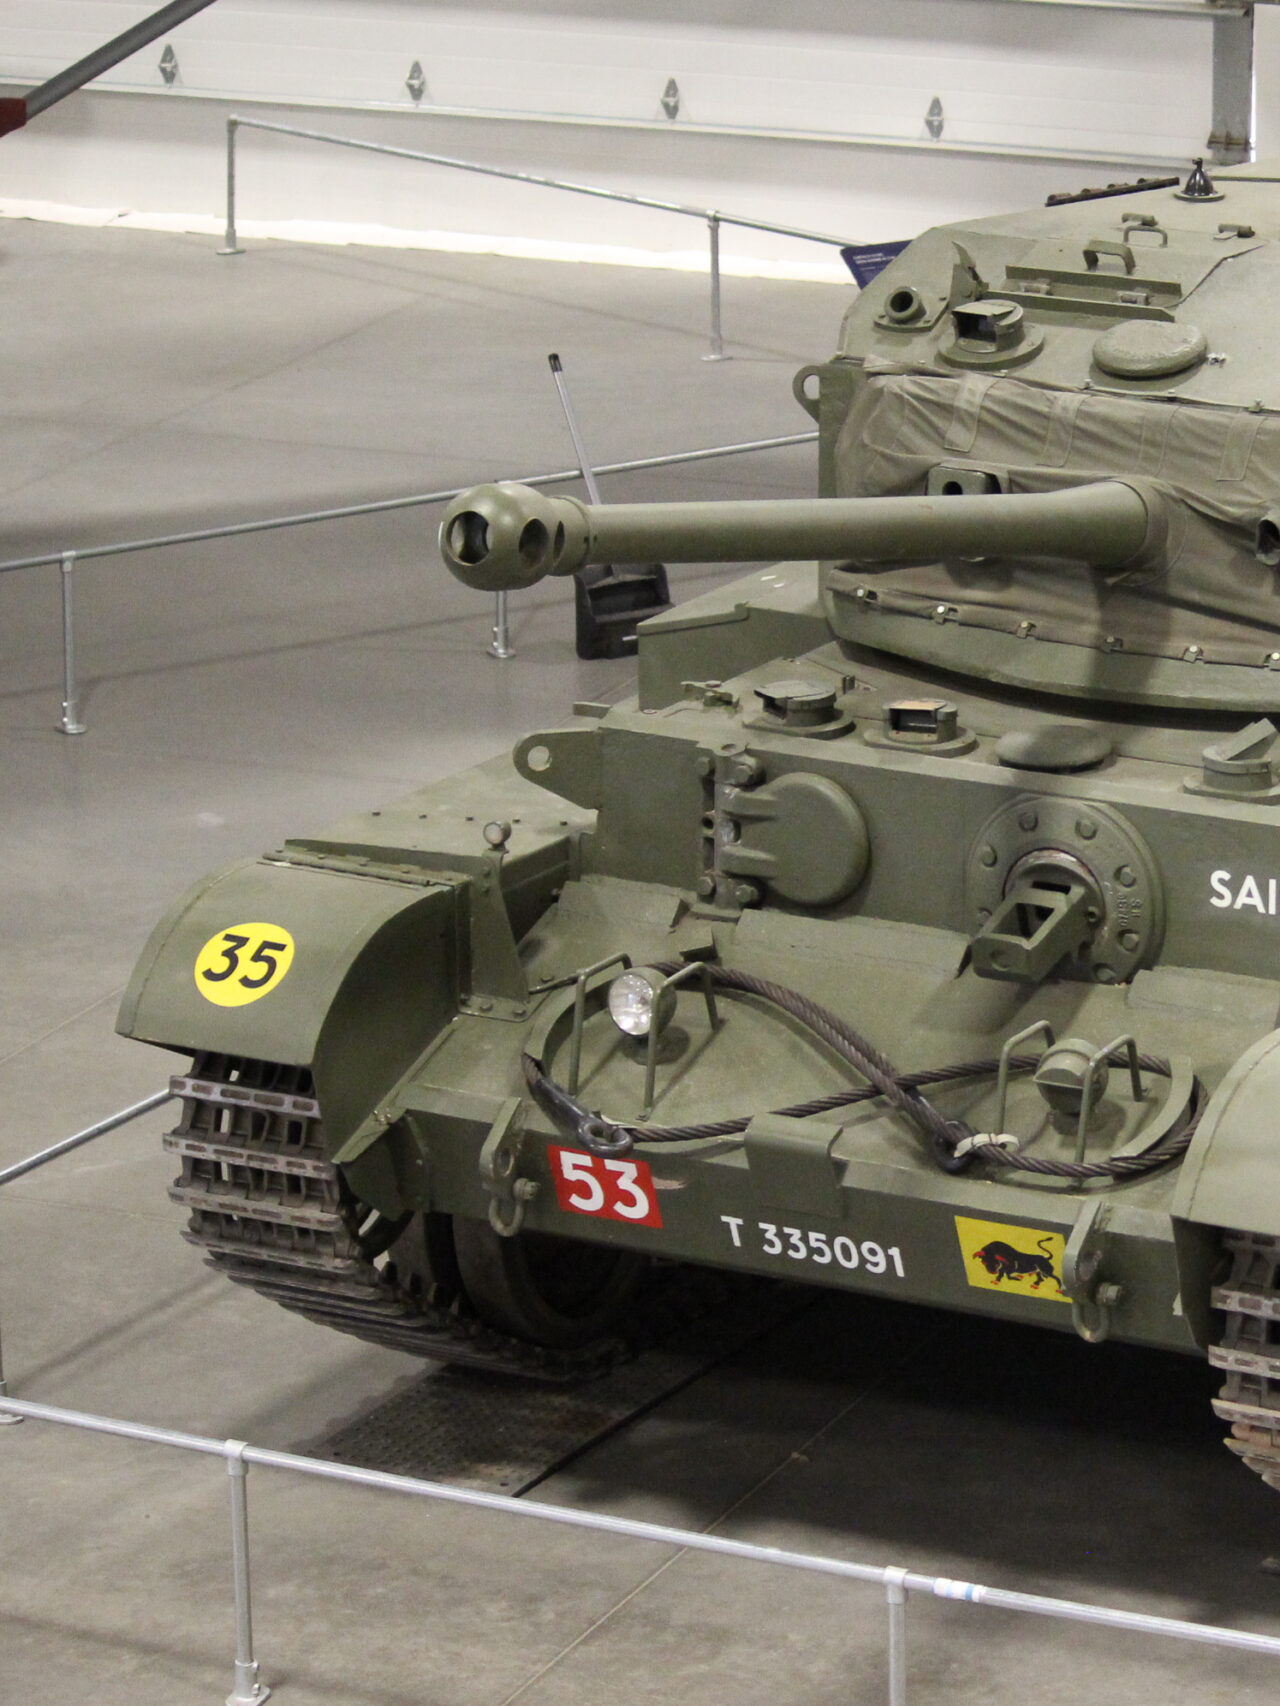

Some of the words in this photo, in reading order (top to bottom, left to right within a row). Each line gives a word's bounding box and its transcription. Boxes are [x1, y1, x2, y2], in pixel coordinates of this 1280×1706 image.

[202, 933, 288, 989] 35
[559, 1150, 650, 1219] 53
[720, 1215, 744, 1247] T
[758, 1222, 905, 1278] 335091
